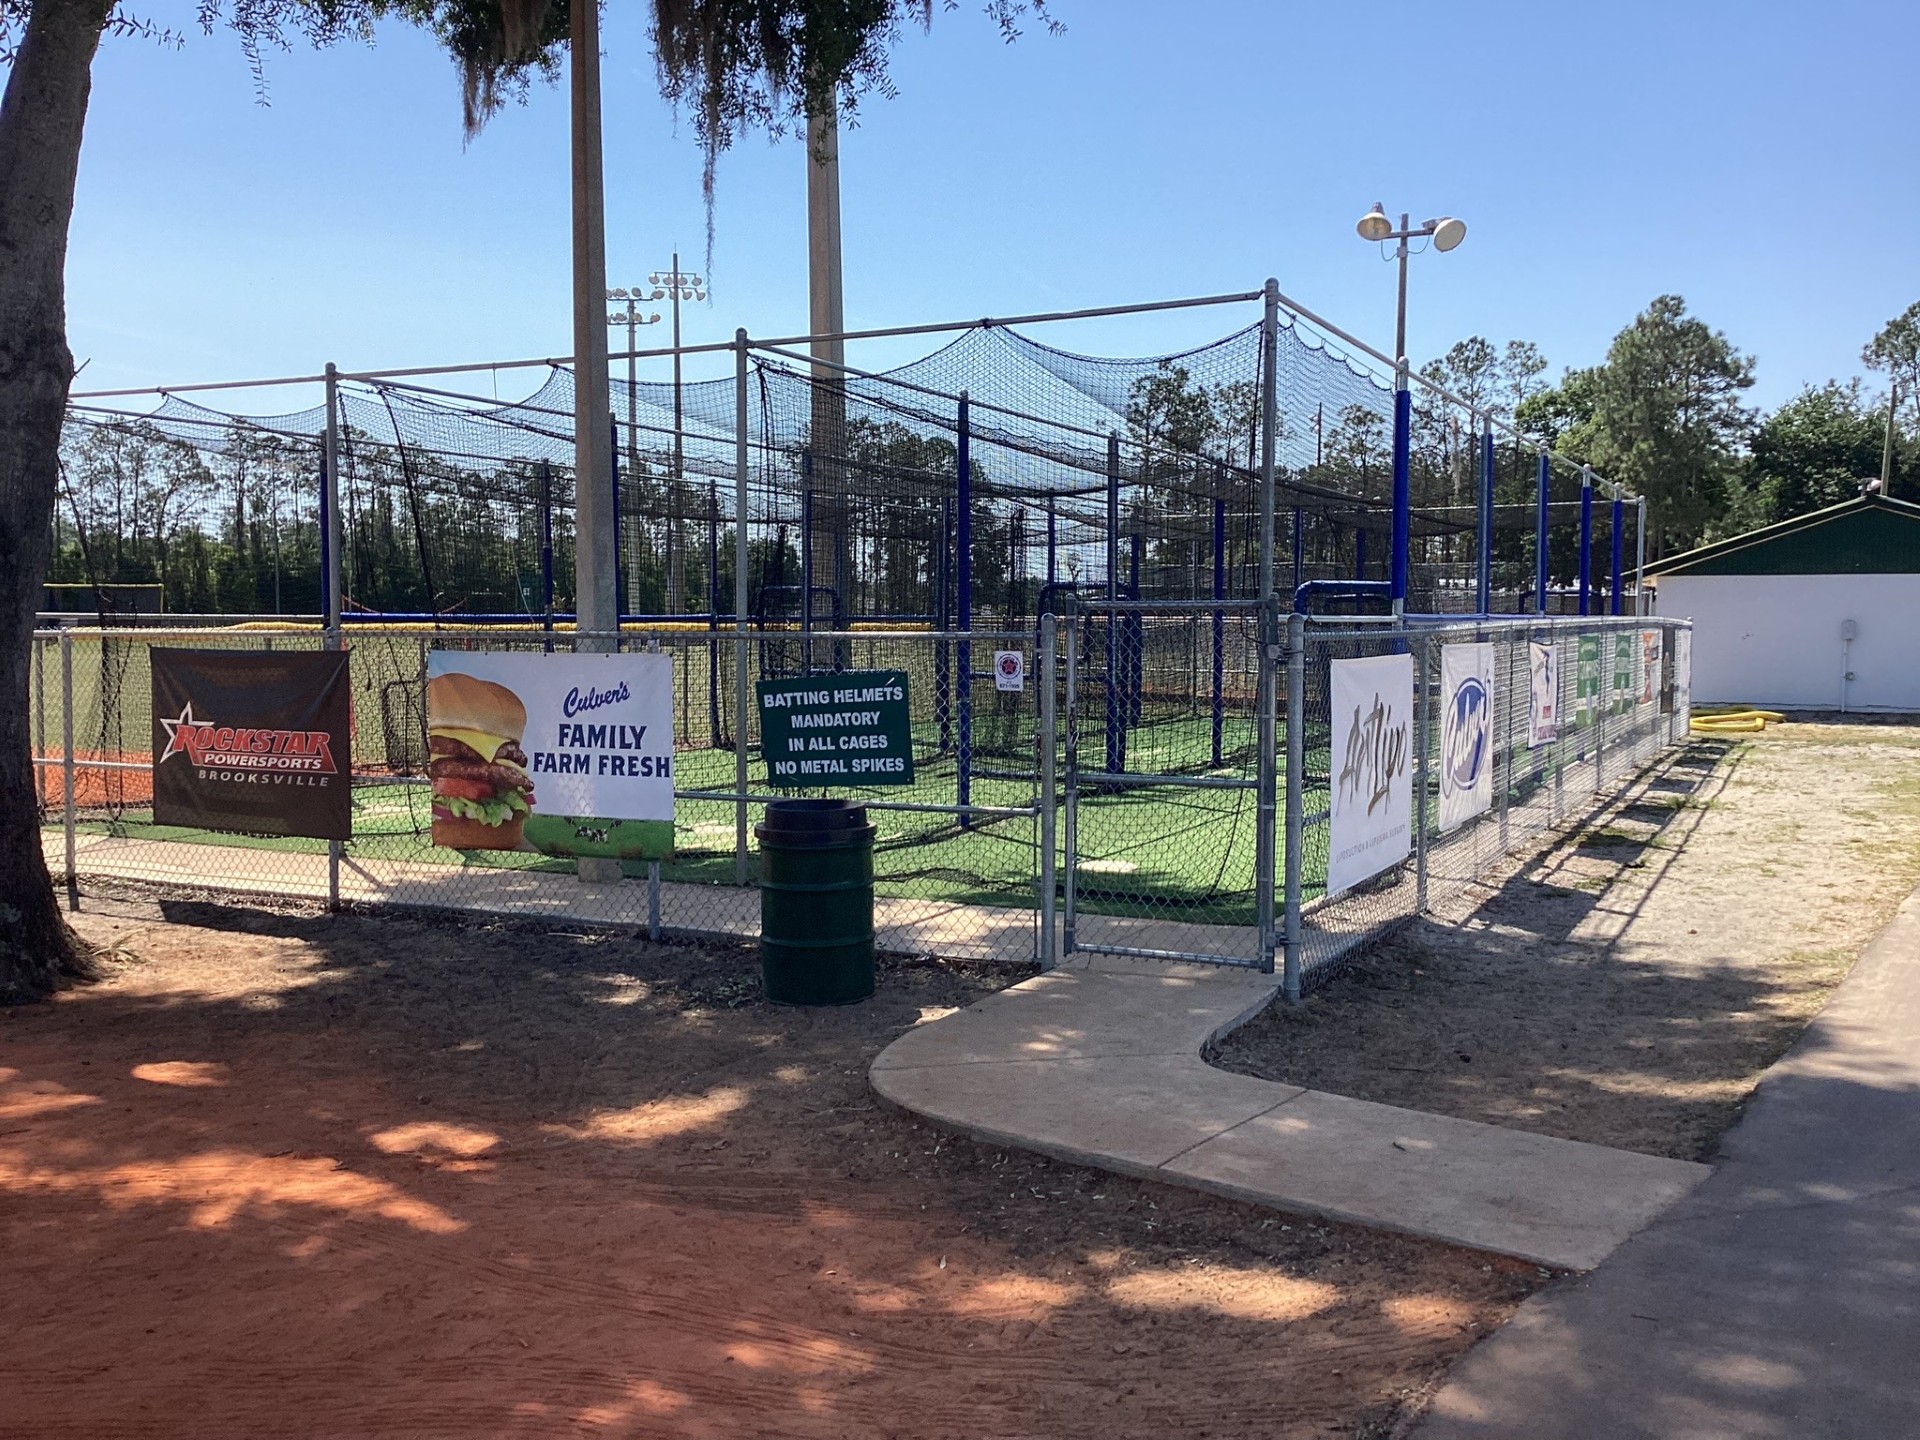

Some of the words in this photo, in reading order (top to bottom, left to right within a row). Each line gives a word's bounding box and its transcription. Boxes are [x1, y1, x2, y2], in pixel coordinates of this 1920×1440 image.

[563, 681, 631, 718] Culver's
[763, 690, 830, 708] BATTING
[833, 686, 904, 704] HELMETS
[791, 711, 881, 729] MANDATORY
[173, 724, 332, 759] ROCKSTAR
[558, 723, 648, 750] FAMILY
[788, 737, 804, 752] IN
[808, 736, 836, 751] ALL
[839, 734, 888, 750] CAGES
[204, 753, 323, 770] POWERSPORTS
[533, 752, 591, 775] FARM
[598, 755, 671, 778] FRESH
[775, 760, 797, 775] NO
[800, 759, 848, 774] METAL
[852, 757, 905, 773] SPIKES
[198, 769, 330, 787] BROOKSVILLE
